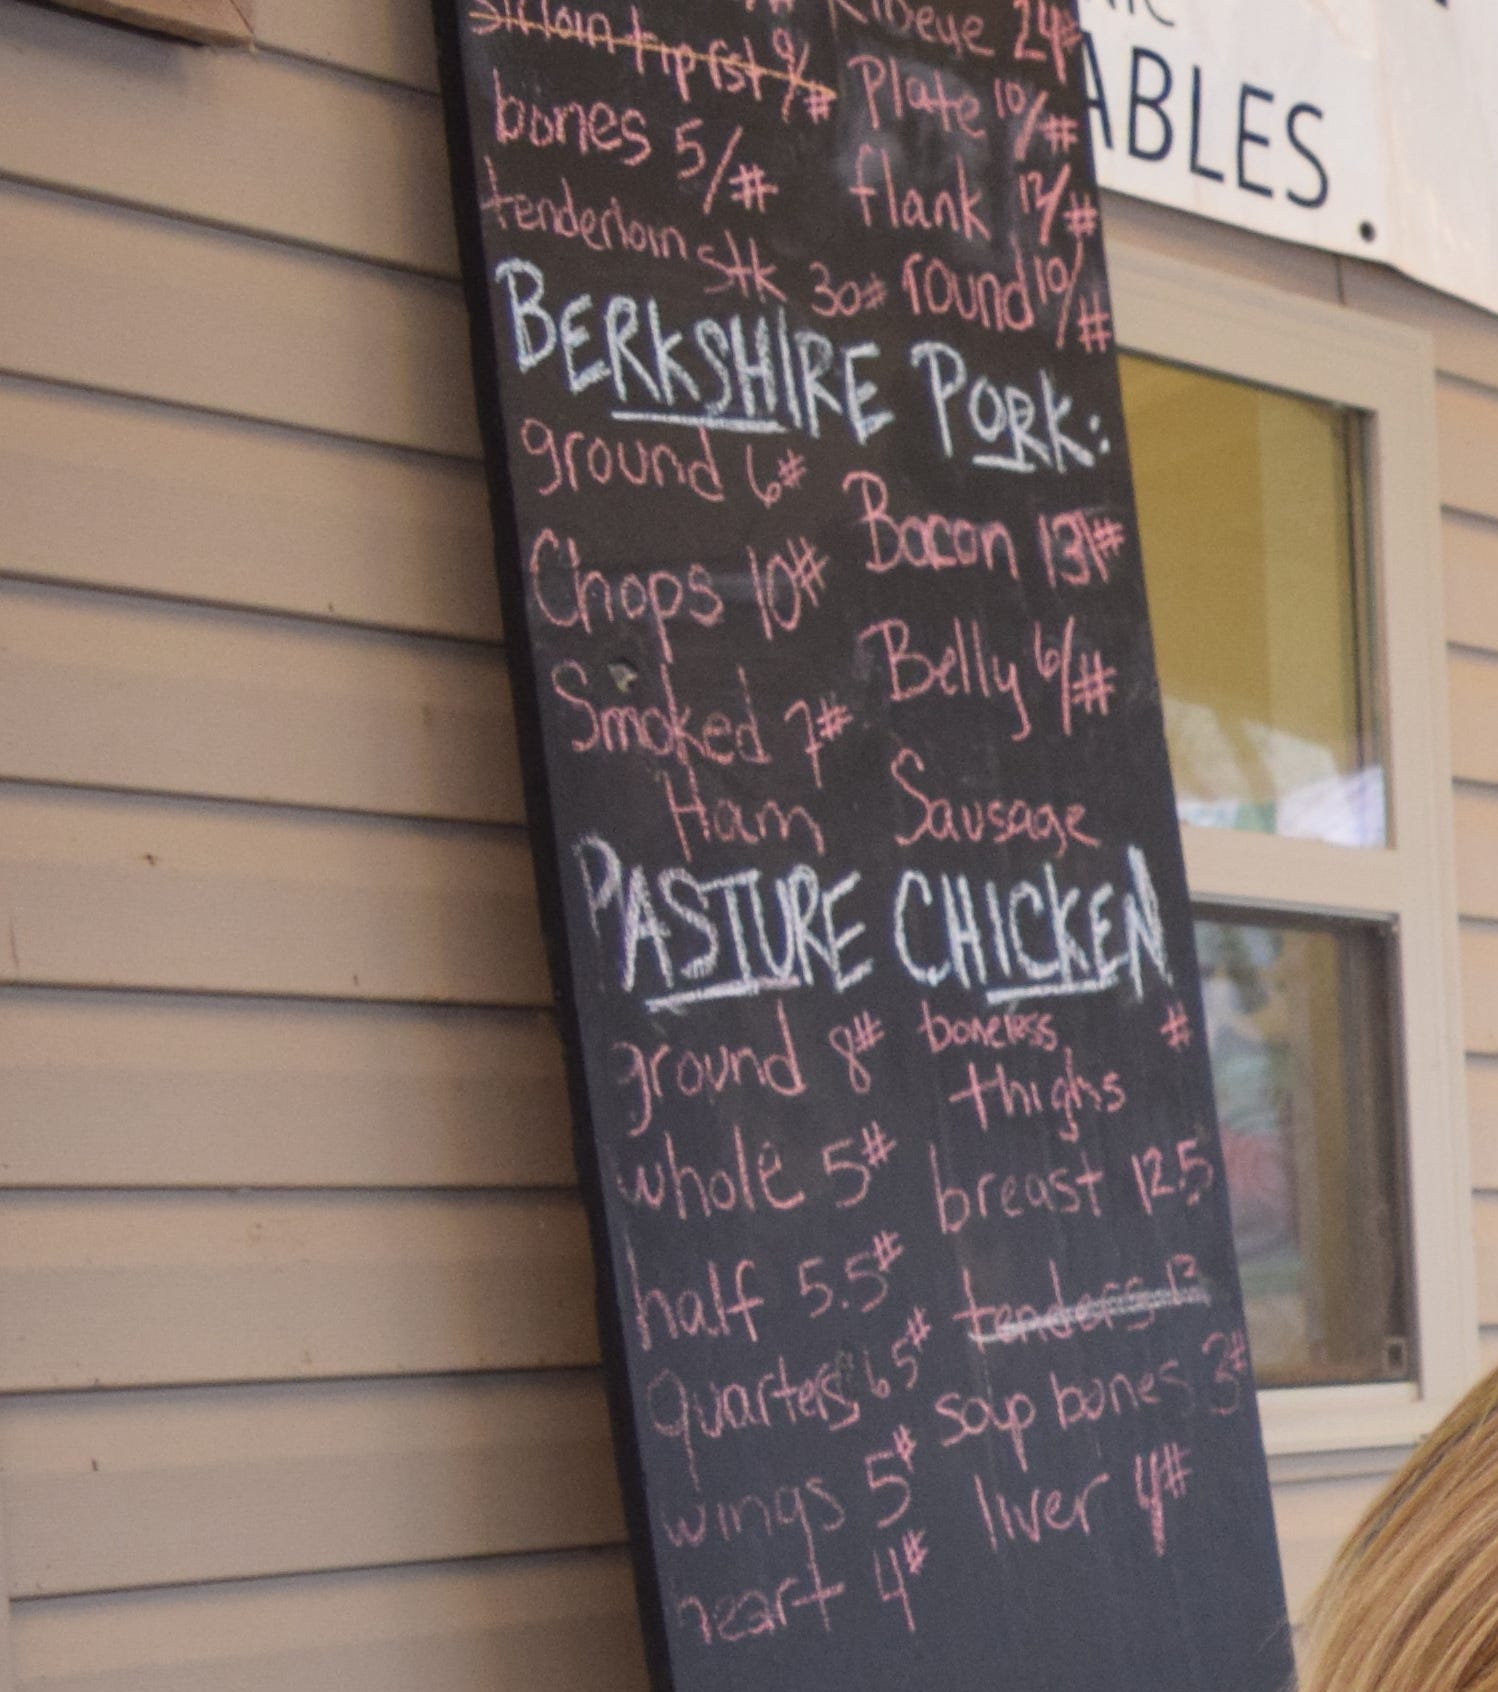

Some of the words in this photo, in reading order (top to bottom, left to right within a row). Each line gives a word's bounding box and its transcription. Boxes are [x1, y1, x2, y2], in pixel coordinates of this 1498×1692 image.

[492, 69, 654, 166] bones
[847, 54, 987, 139] Plate
[495, 257, 894, 446] BERKSHIRE
[520, 418, 725, 503] ground
[842, 470, 1021, 573] Bacon
[529, 527, 725, 665] Chops
[858, 614, 1033, 743] Belly
[664, 764, 827, 864] Ham
[891, 748, 1101, 859] Sausage
[574, 832, 875, 993] PASTURE
[893, 843, 1176, 1002] CHICKEN
[611, 1001, 808, 1137] ground
[614, 1130, 807, 1221] whole
[928, 1142, 1105, 1236] breast
[624, 1230, 765, 1352] half
